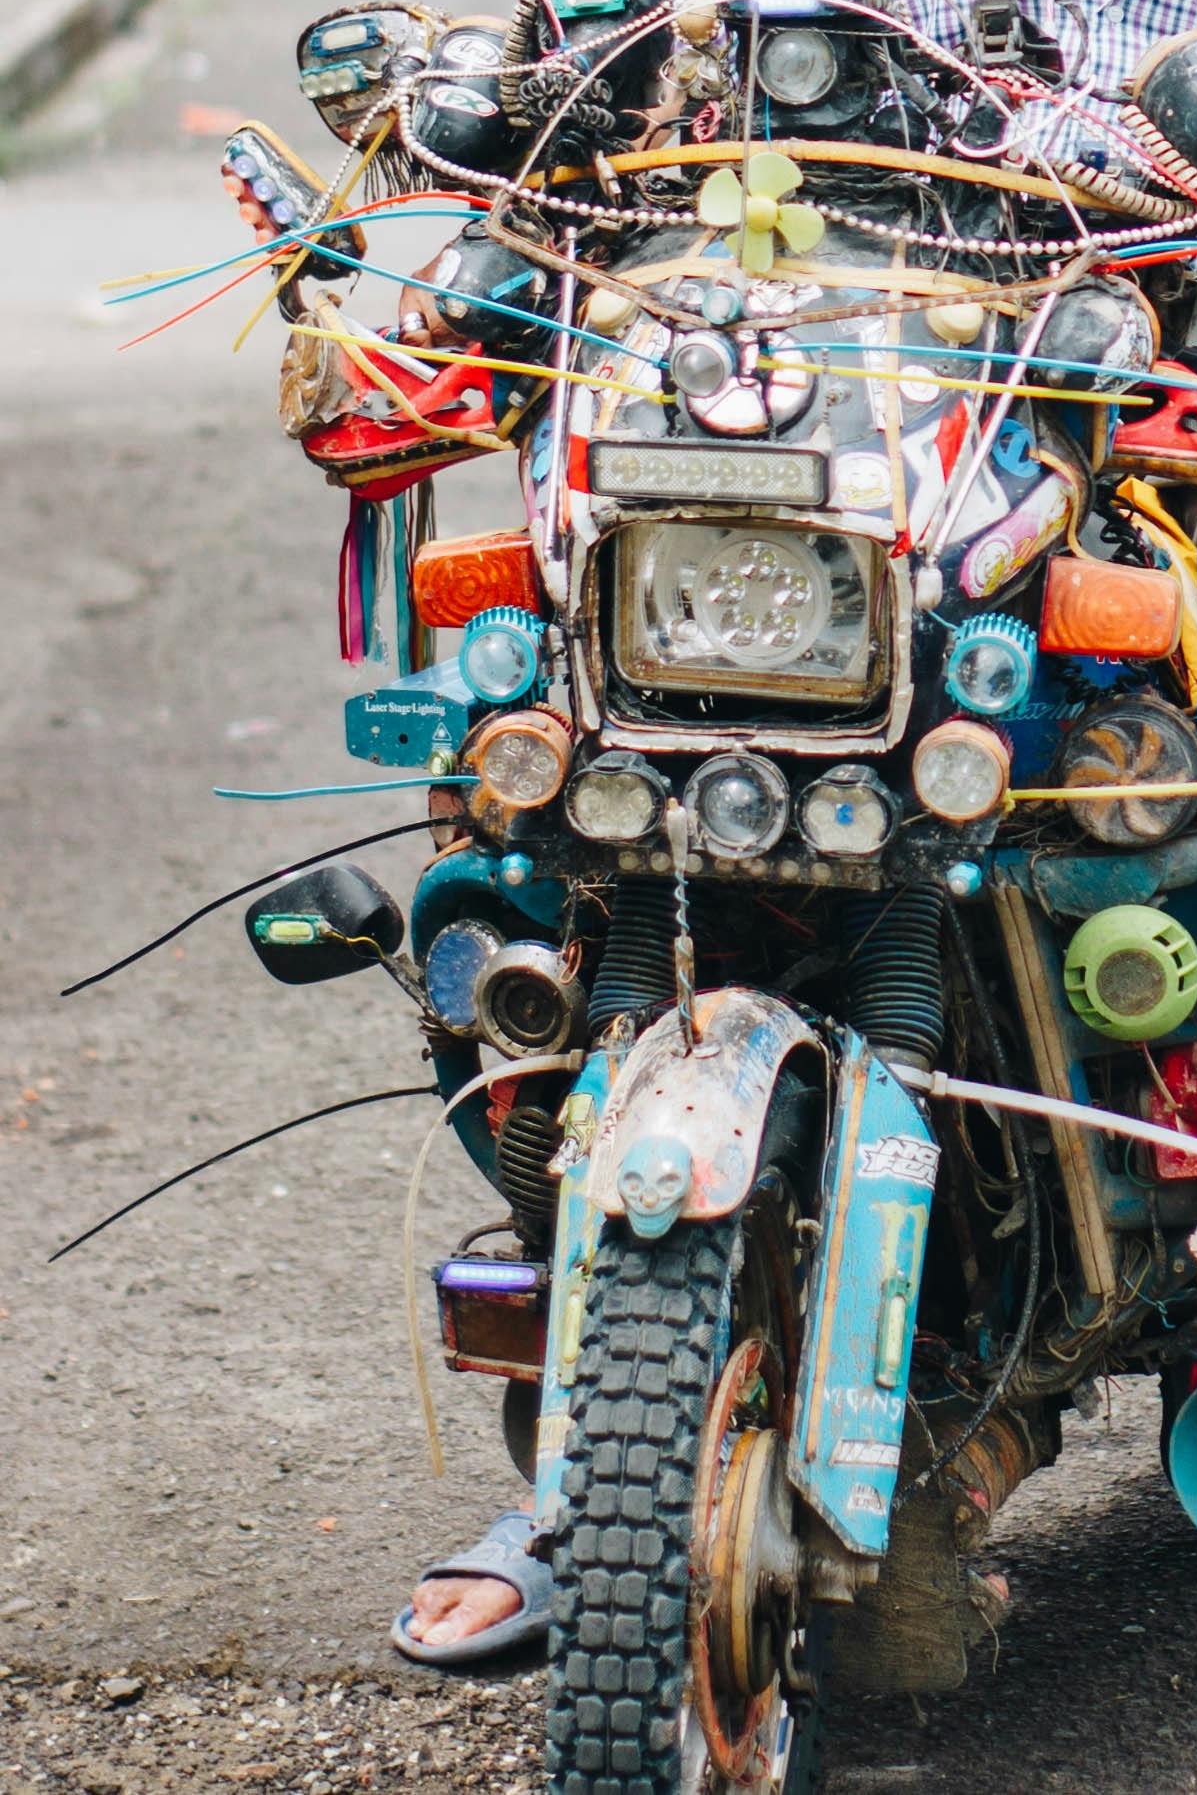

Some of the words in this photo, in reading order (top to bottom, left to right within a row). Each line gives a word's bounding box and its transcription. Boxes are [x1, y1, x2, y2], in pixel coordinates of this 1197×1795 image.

[365, 701, 388, 713] Laser
[389, 702, 411, 716] Stage
[412, 702, 446, 717] Lighting
